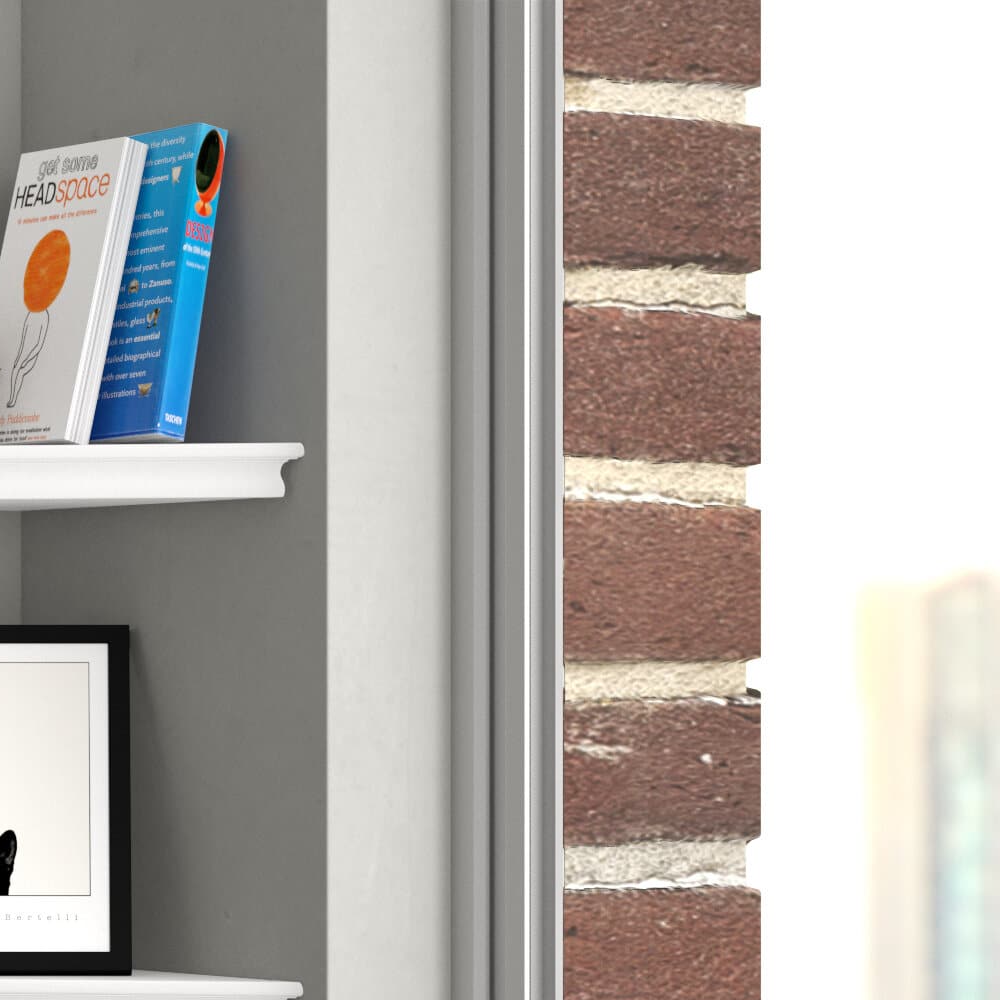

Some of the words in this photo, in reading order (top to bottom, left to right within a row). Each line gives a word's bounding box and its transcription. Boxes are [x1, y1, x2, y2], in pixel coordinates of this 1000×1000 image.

[161, 136, 186, 147] diversity
[177, 151, 195, 161] while
[37, 156, 61, 182] get
[62, 154, 99, 175] some
[153, 209, 165, 217] this
[140, 244, 166, 255] eminent
[160, 259, 176, 269] from
[133, 332, 161, 343] essential
[124, 349, 161, 363] biographical
[115, 372, 129, 380] over
[129, 370, 147, 379] seven
[102, 387, 137, 400] illustrations
